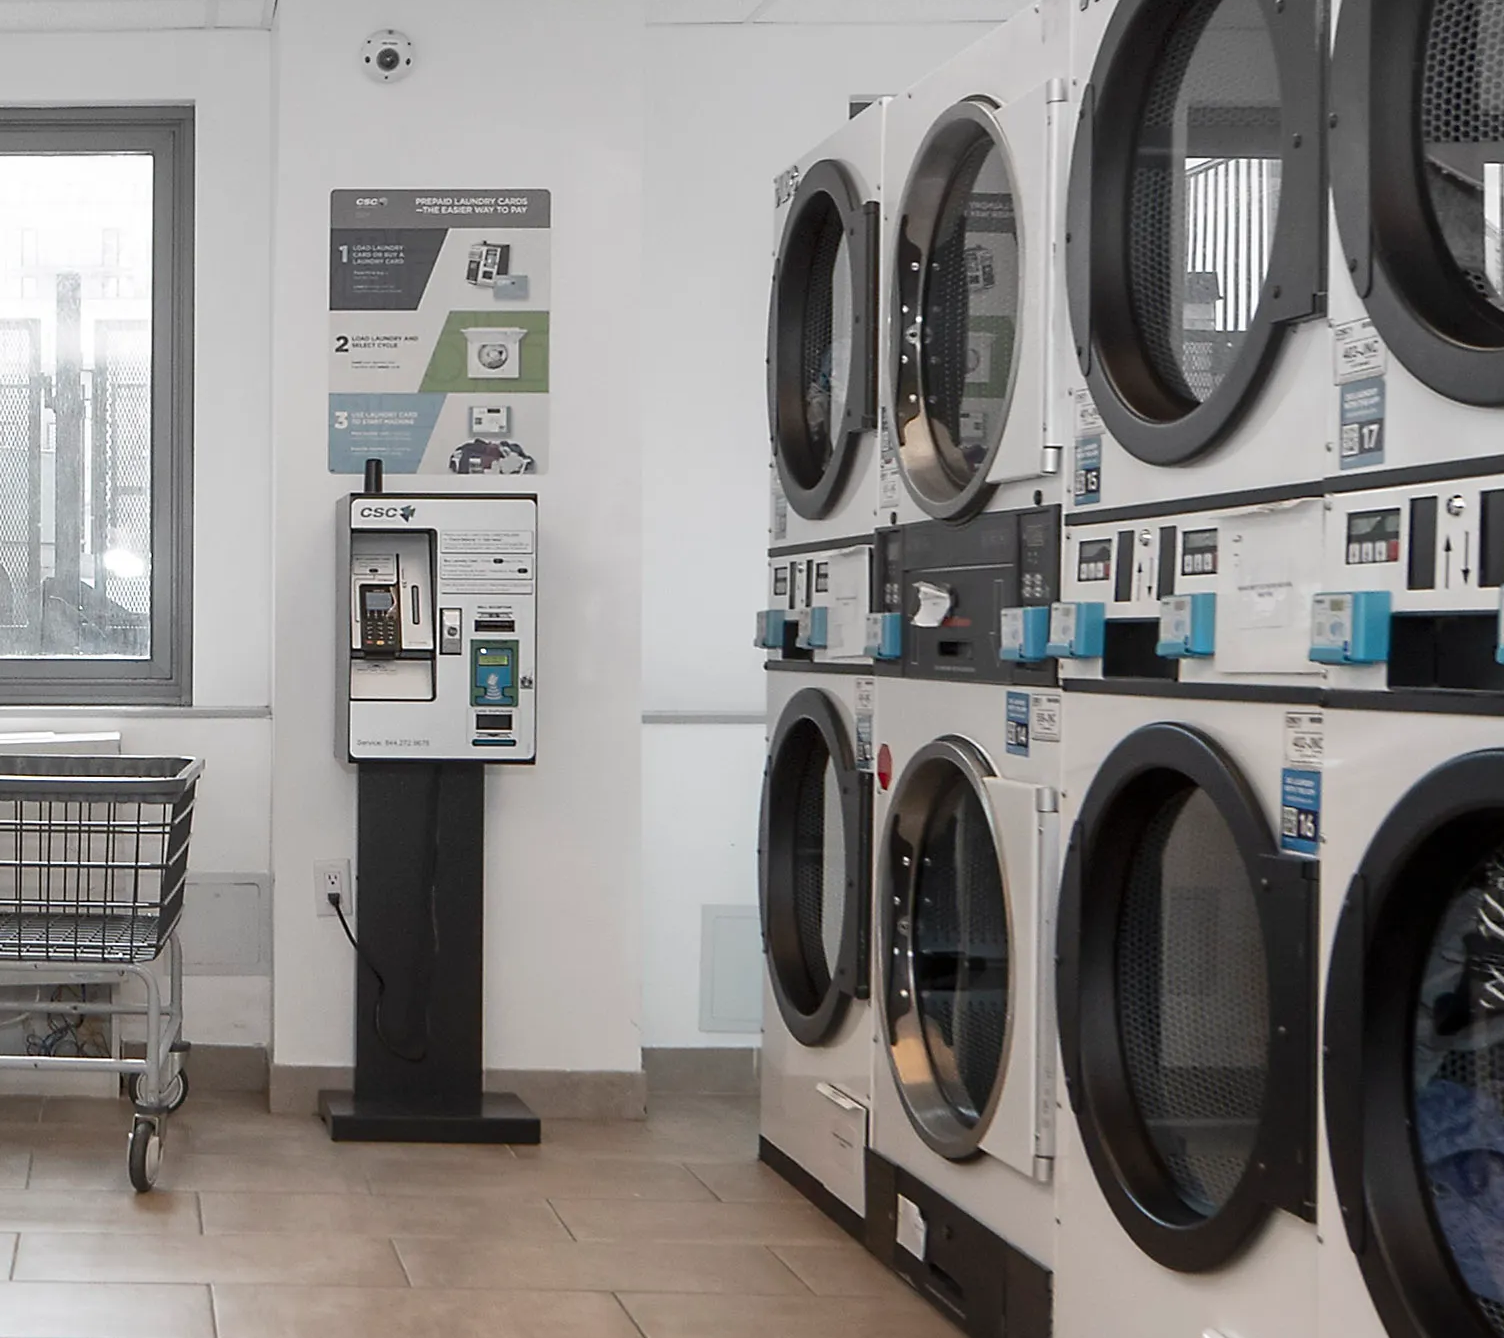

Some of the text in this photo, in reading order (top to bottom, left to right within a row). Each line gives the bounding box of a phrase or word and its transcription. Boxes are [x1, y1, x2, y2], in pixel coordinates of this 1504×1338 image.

[356, 198, 378, 206] CSC
[415, 197, 528, 206] PREPAID LAUNDRY CARDS
[441, 206, 472, 214] EASIER
[473, 206, 495, 214] WAY
[496, 206, 509, 214] TO
[510, 206, 528, 214] PAY
[339, 244, 348, 263] 1
[334, 335, 349, 353] 2
[334, 411, 348, 429] 3
[1361, 424, 1380, 449] 17
[360, 506, 398, 518] CSC
